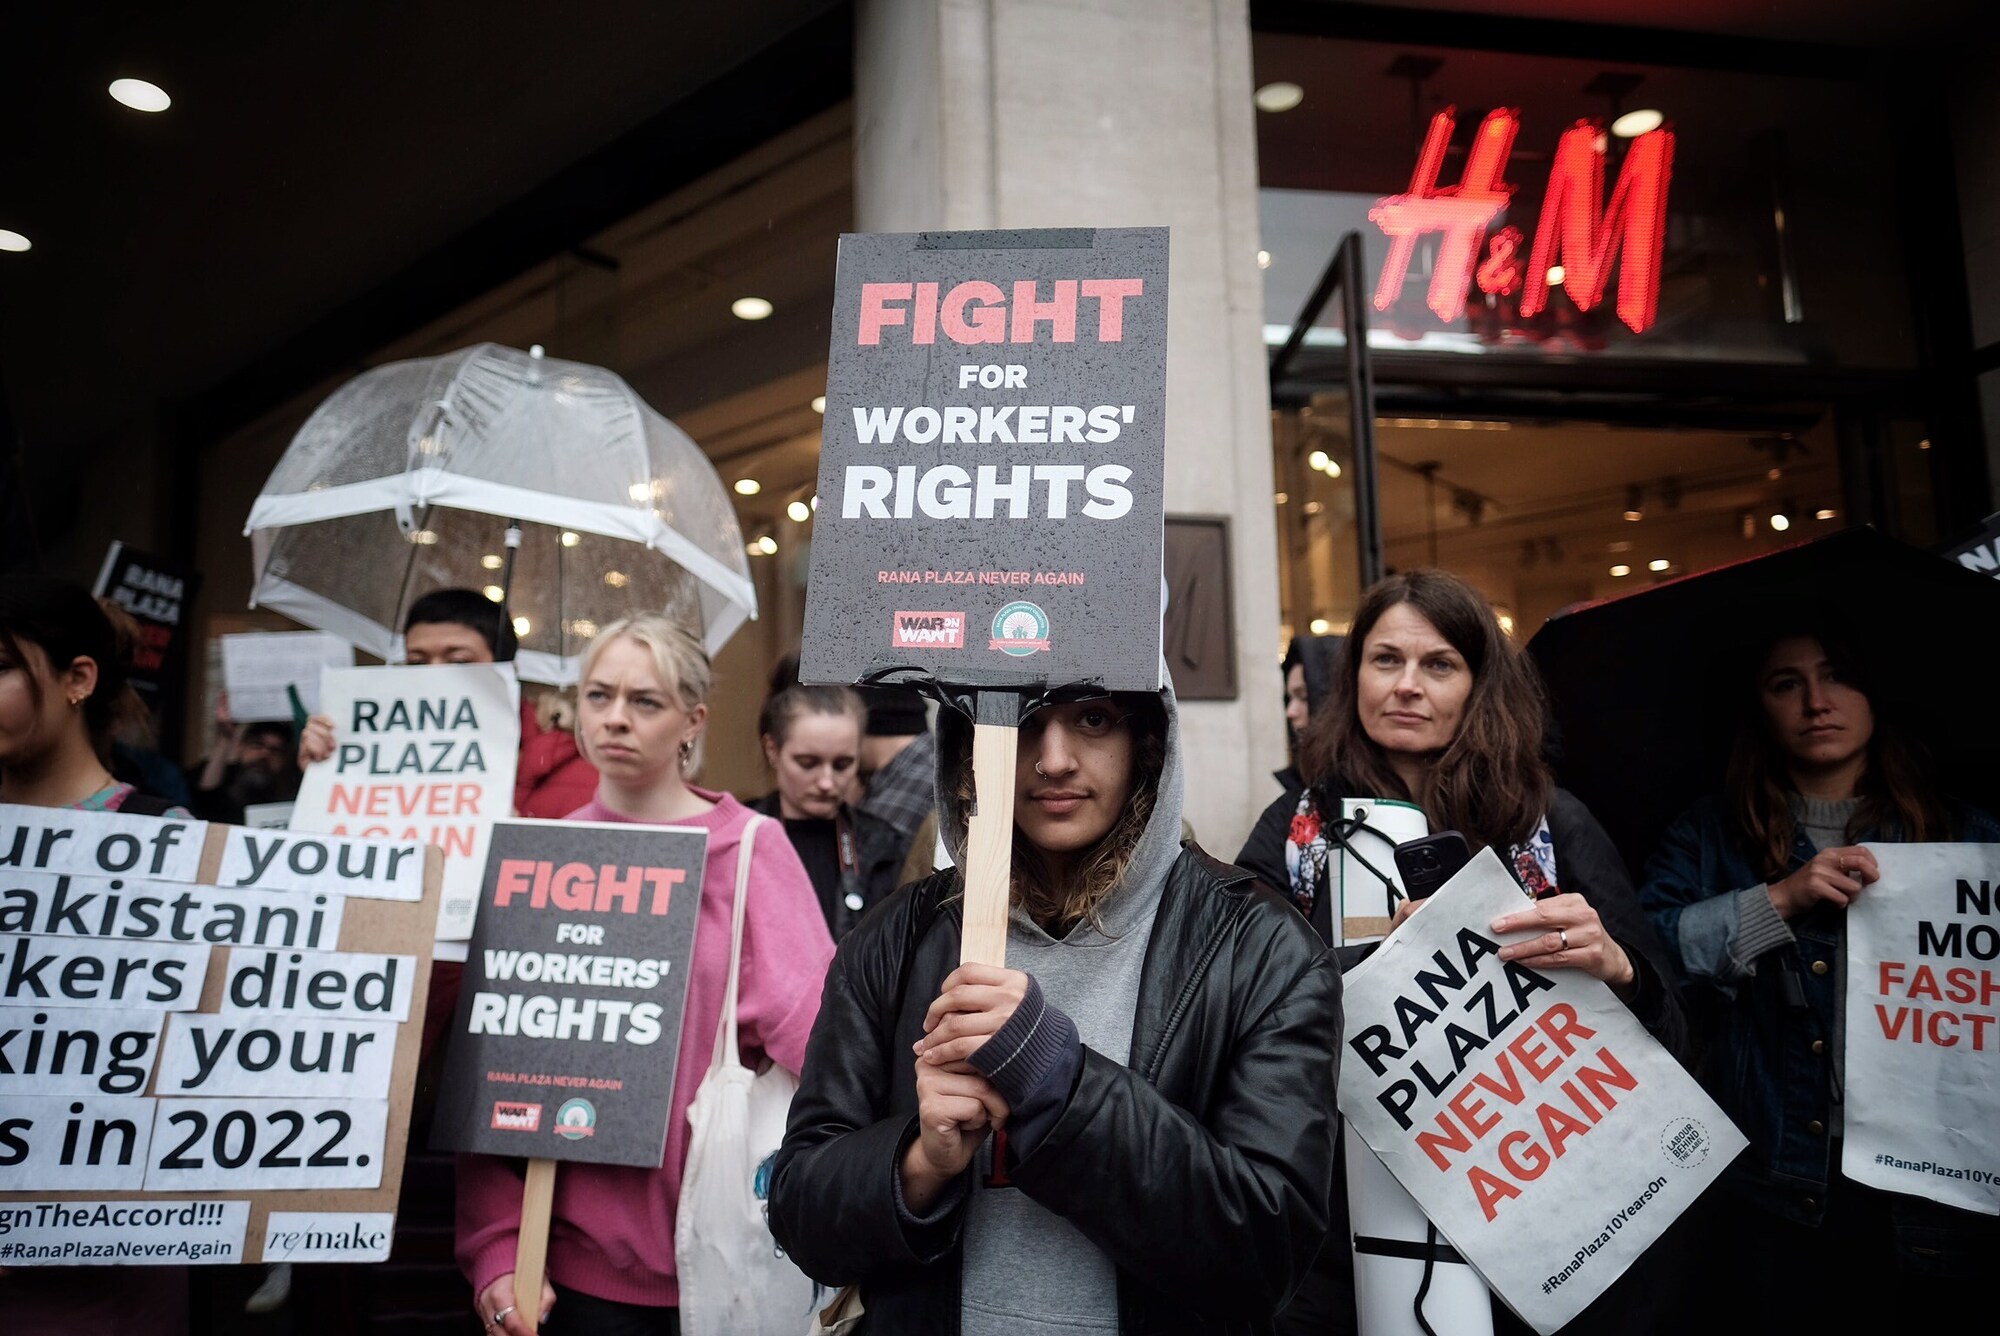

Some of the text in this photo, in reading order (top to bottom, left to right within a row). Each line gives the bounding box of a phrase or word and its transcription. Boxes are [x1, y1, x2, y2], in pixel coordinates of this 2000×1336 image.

[1369, 107, 1674, 333] H&M
[858, 278, 1143, 345] FIGHT
[958, 365, 1028, 389] FOR
[853, 405, 1136, 444] WORKERS'
[841, 464, 1134, 520] RIGHTS
[878, 570, 1085, 586] RANA PLAZA NEVER AGAIN
[899, 627, 959, 643] WANT
[900, 616, 960, 631] WAR ON
[351, 697, 480, 733] RANA
[336, 740, 487, 776] PLAZA
[327, 783, 483, 816] NEVER
[96, 823, 187, 874] of
[236, 835, 415, 886] your
[494, 859, 687, 916] FIGHT
[1956, 879, 2000, 915] N
[0, 875, 327, 948] akistani
[556, 923, 606, 946] FOR
[0, 938, 398, 1012] kers died
[483, 950, 672, 990] WORKERS'
[468, 992, 665, 1046] RIGHTS
[1348, 927, 1502, 1077] RANA
[181, 1026, 375, 1088] your
[1376, 960, 1557, 1131] PLAZA
[517, 1073, 552, 1086] PLAZA
[553, 1075, 588, 1088] NEVER
[588, 1078, 623, 1091] AGAIN
[1413, 1002, 1597, 1173] NEVER
[59, 1101, 138, 1166] in
[159, 1109, 371, 1170] 2022.
[1468, 1045, 1639, 1223] AGAIN
[1666, 1123, 1694, 1151] LABOUR
[1672, 1130, 1700, 1158] BEHIND
[1679, 1137, 1705, 1162] THE LABEL
[1, 1240, 232, 1259] #RanaPlazaNeverAgain
[1541, 1176, 1668, 1295] #RanaPlaza10YearsOn
